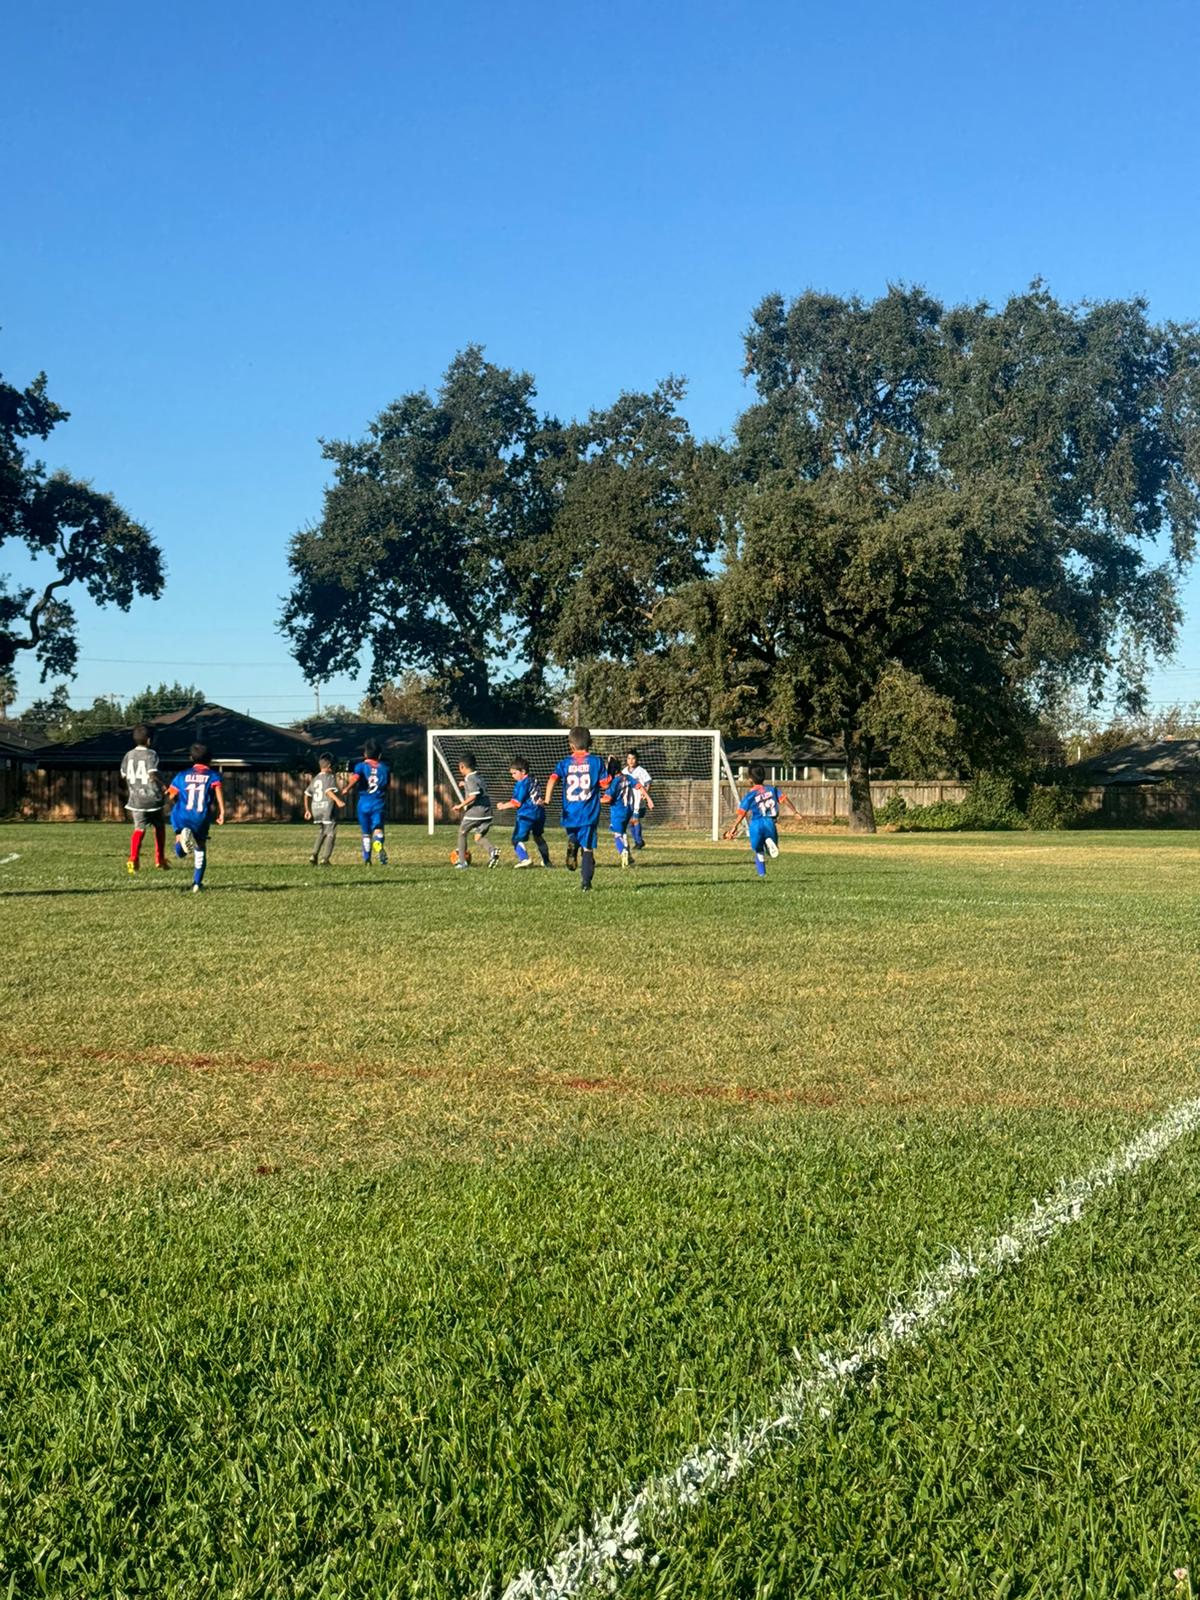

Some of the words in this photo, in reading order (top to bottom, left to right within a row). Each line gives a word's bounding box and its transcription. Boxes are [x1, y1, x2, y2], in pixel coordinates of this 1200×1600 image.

[126, 759, 150, 785] 44
[185, 783, 206, 812] 11
[313, 779, 324, 802] 3
[566, 773, 591, 802] 29
